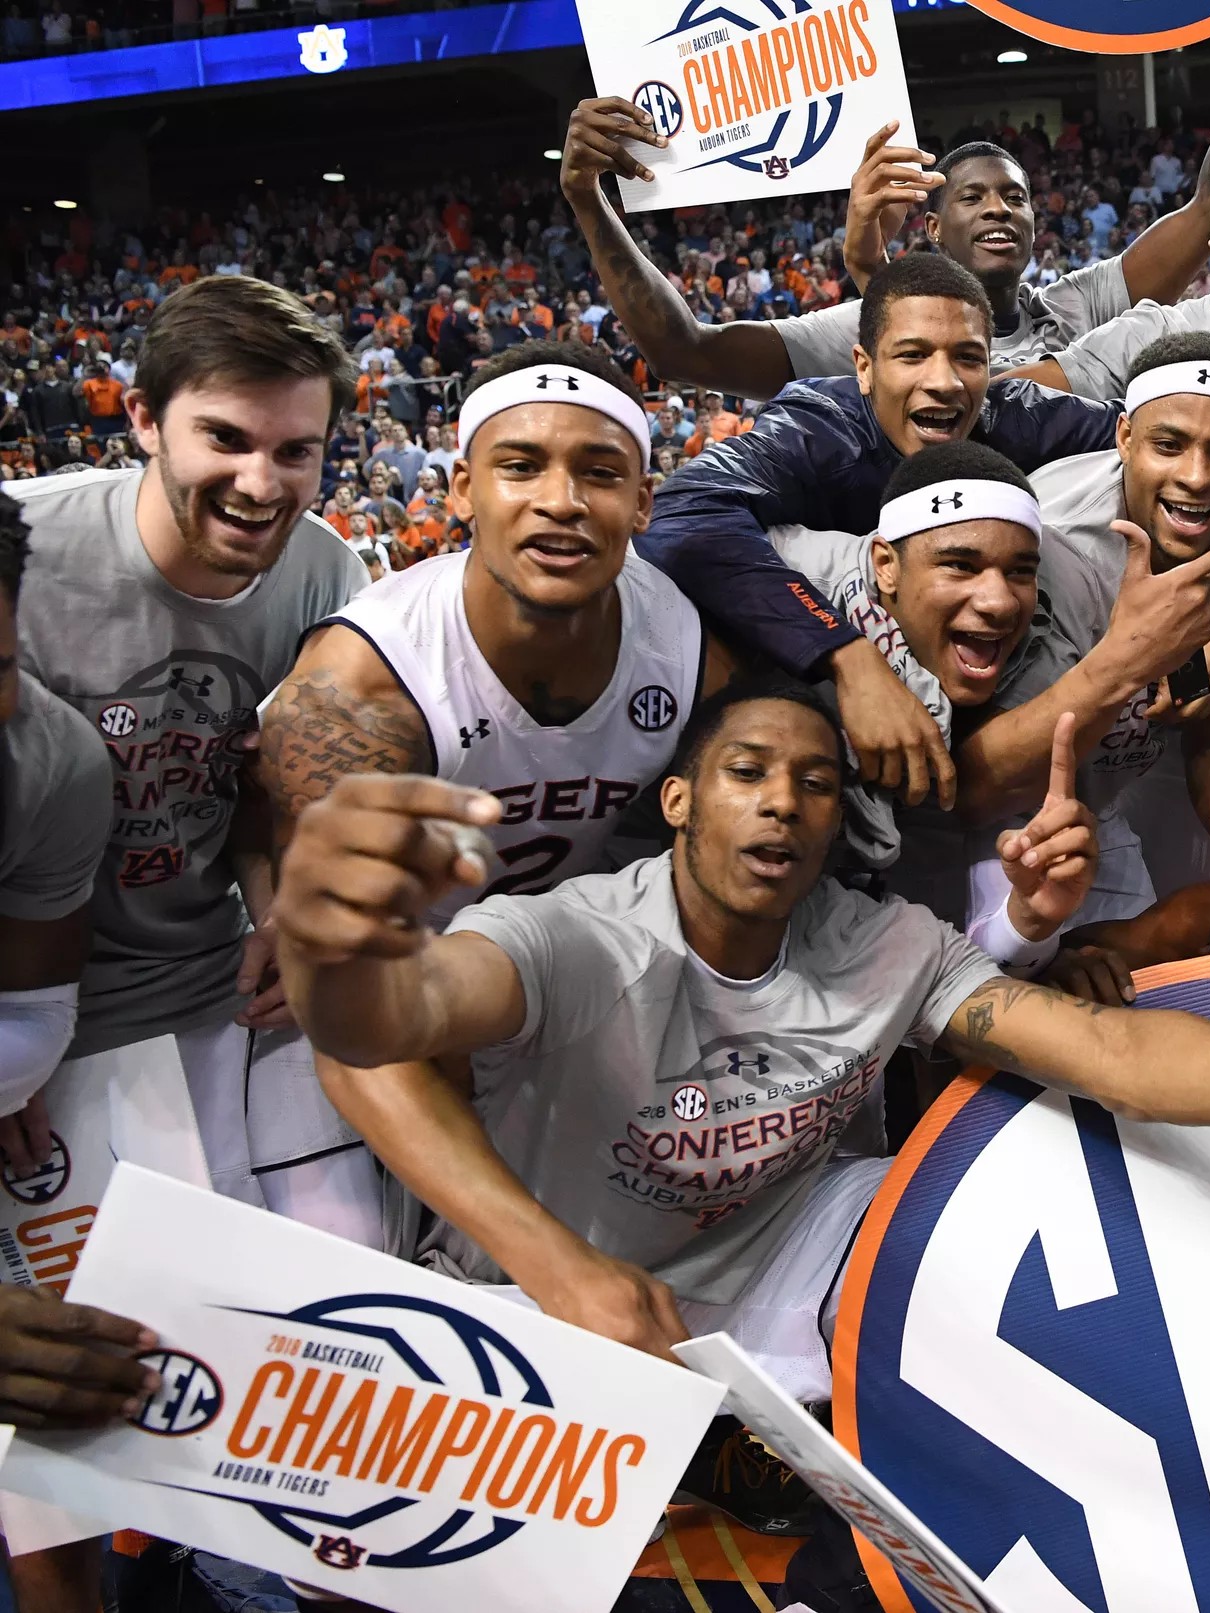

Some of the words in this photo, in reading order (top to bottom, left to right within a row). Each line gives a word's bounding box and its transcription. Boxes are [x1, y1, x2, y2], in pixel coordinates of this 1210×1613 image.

[677, 43, 693, 58] 2018
[693, 27, 731, 52] BASKETBALL
[683, 0, 878, 134] CHAMPIONS
[699, 133, 726, 152] AUBURN
[726, 123, 751, 145] TIGERS
[786, 583, 839, 629] AUBURN
[101, 704, 138, 737] SEC
[632, 687, 676, 730] SEC
[673, 1085, 707, 1121] SEC
[265, 1333, 302, 1358] 2018
[302, 1340, 384, 1374] BASKETBALL
[136, 1352, 217, 1433] EC
[226, 1361, 645, 1528] CHAMPIONS
[212, 1460, 274, 1490] AUBURN
[276, 1471, 330, 1498] TIGERS
